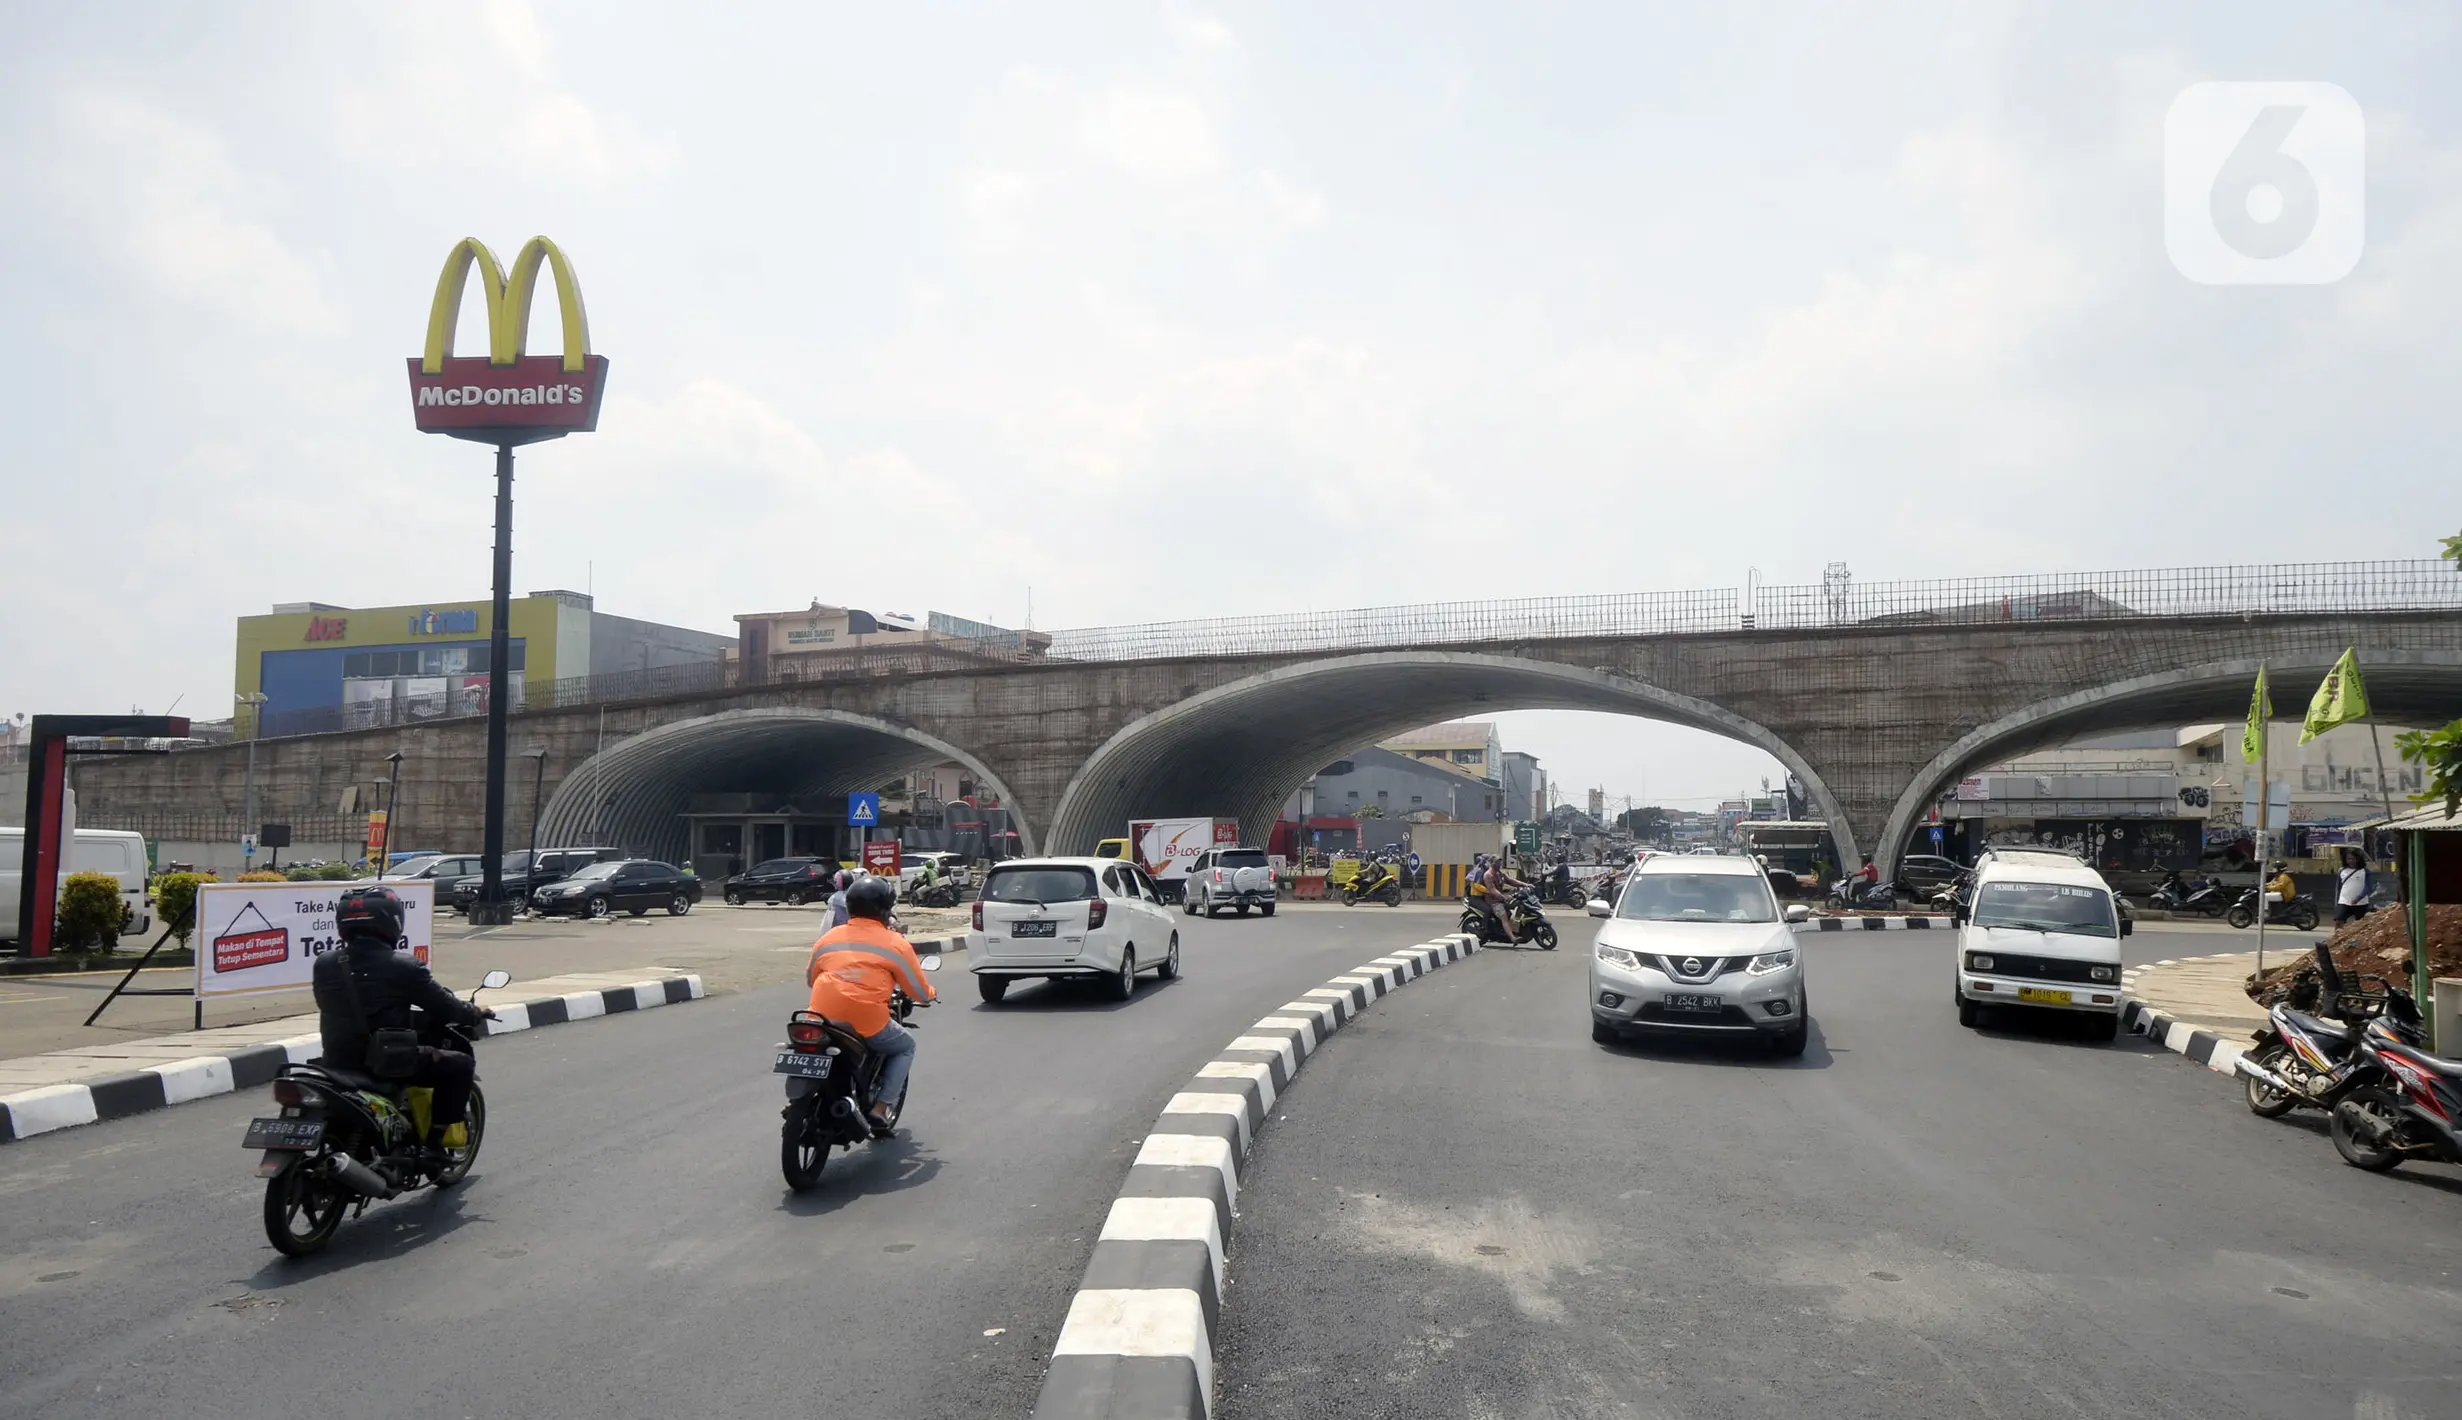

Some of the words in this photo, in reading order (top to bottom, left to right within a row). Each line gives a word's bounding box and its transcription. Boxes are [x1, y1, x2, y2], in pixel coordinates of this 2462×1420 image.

[418, 384, 583, 407] McDonald's
[303, 616, 347, 642] ACE
[1165, 844, 1201, 857] B-LOG
[294, 900, 324, 913] Take
[312, 918, 334, 931] dan
[1013, 923, 1019, 932] B
[217, 942, 244, 953] Makan
[246, 938, 254, 949] di
[255, 935, 284, 948] Tempat
[300, 935, 349, 957] Teta
[218, 954, 241, 965] Tutup
[242, 948, 285, 961] Sementara
[1666, 995, 1673, 1005] B
[777, 1055, 784, 1064] B
[787, 1055, 809, 1066] 6742
[813, 1057, 830, 1068] SVT
[253, 1122, 262, 1133] B
[298, 1123, 321, 1135] EXP
